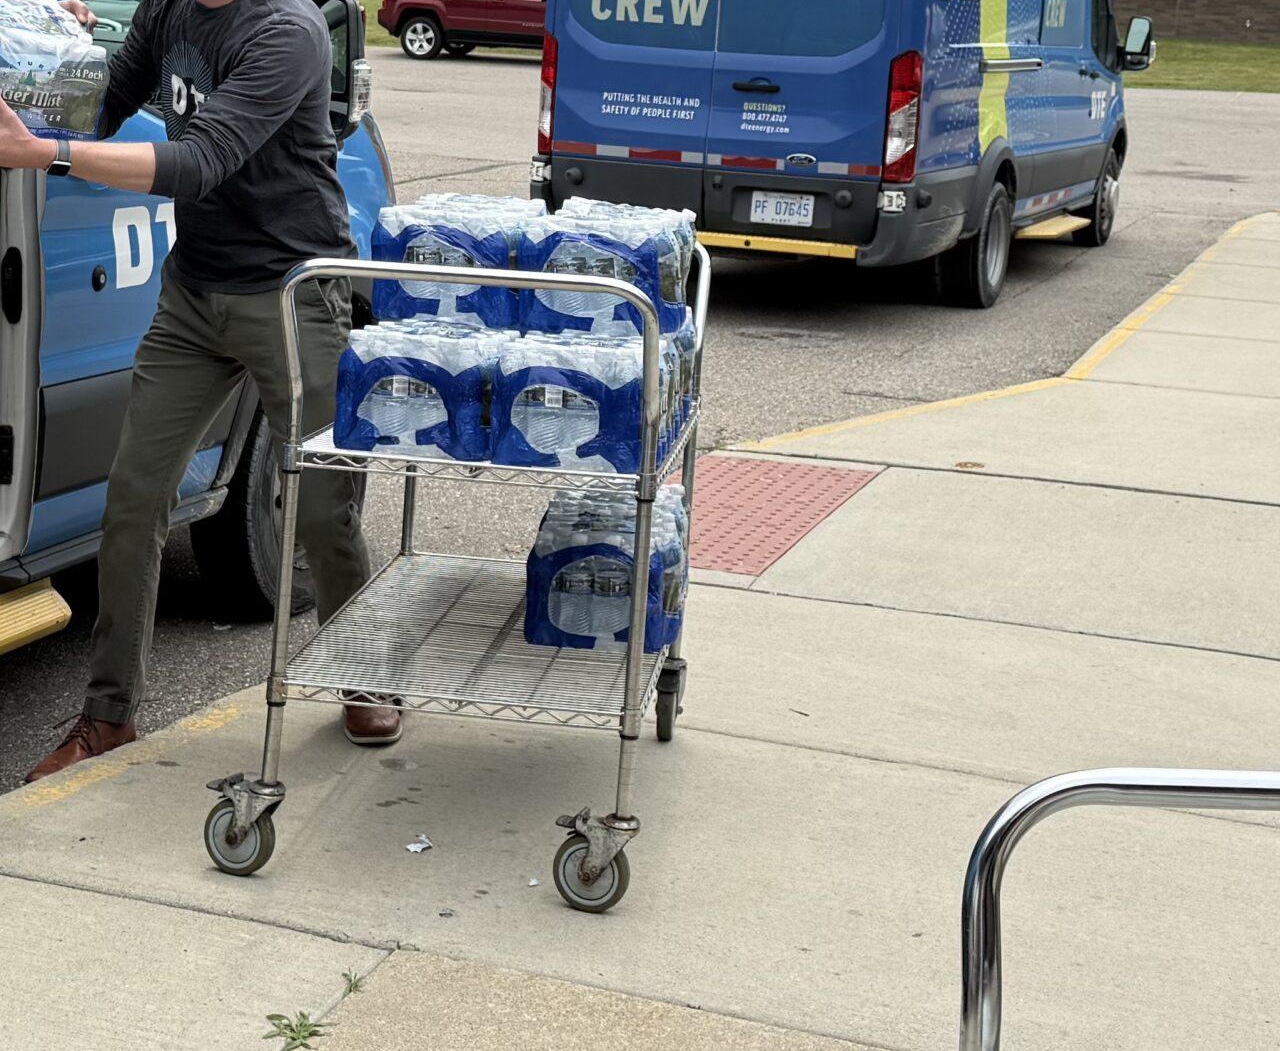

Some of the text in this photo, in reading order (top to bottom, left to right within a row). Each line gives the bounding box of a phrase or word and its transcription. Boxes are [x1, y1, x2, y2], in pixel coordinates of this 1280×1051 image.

[70, 69, 81, 78] 24
[82, 69, 104, 81] Pack
[171, 73, 208, 116] DT
[603, 92, 700, 108] PUTTING THE HEALTH AND
[601, 104, 695, 120] SAFETY OF PEOPLE FIRST
[754, 199, 809, 217] PF 07645
